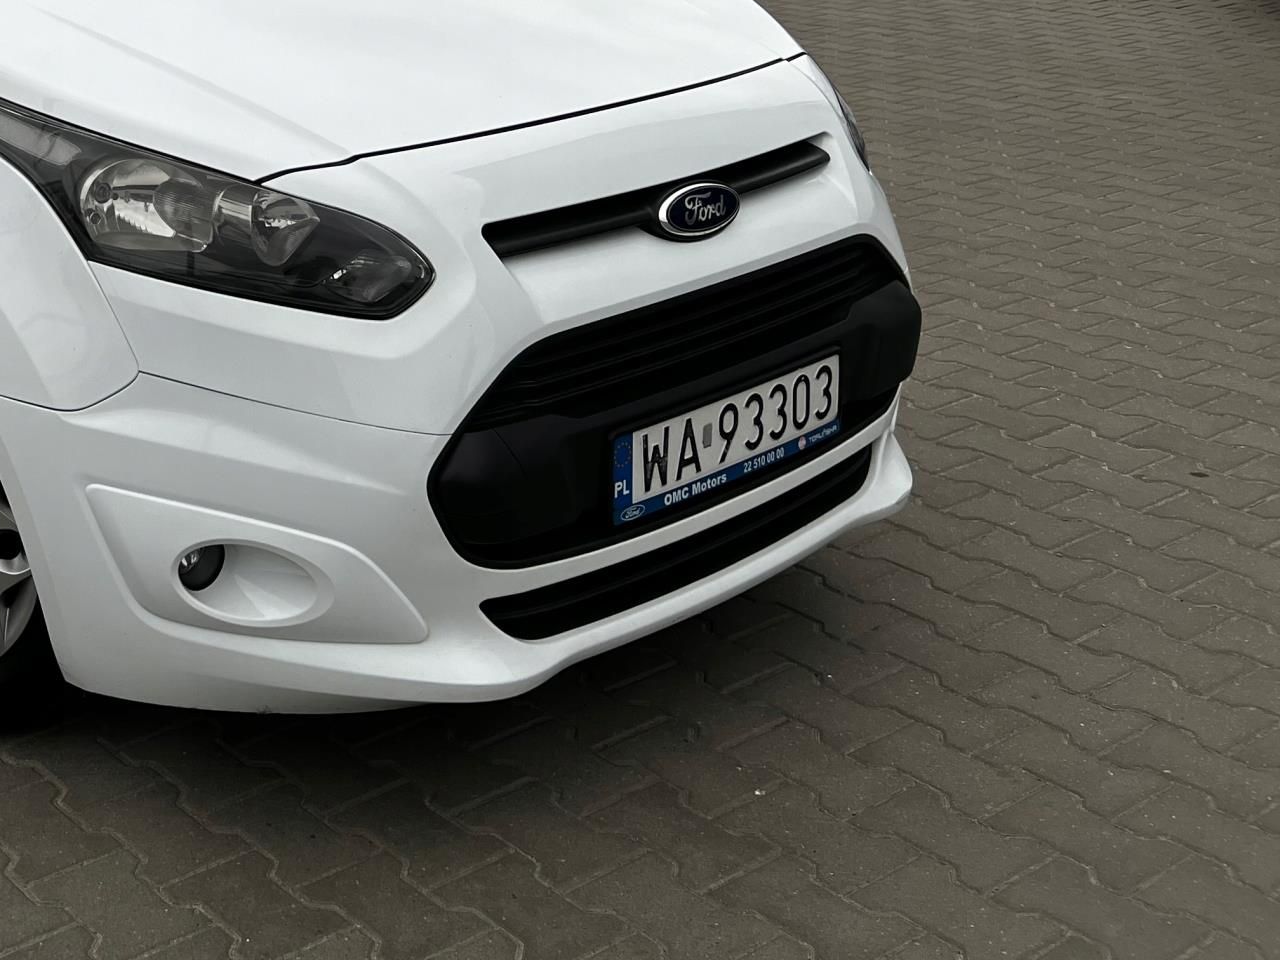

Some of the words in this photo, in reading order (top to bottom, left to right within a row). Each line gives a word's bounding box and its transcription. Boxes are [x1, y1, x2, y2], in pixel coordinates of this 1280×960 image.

[684, 192, 726, 226] Ford
[642, 417, 702, 494] WA
[718, 364, 833, 465] 93303
[614, 479, 630, 498] PL
[664, 487, 689, 506] OMC
[692, 473, 728, 496] Motors
